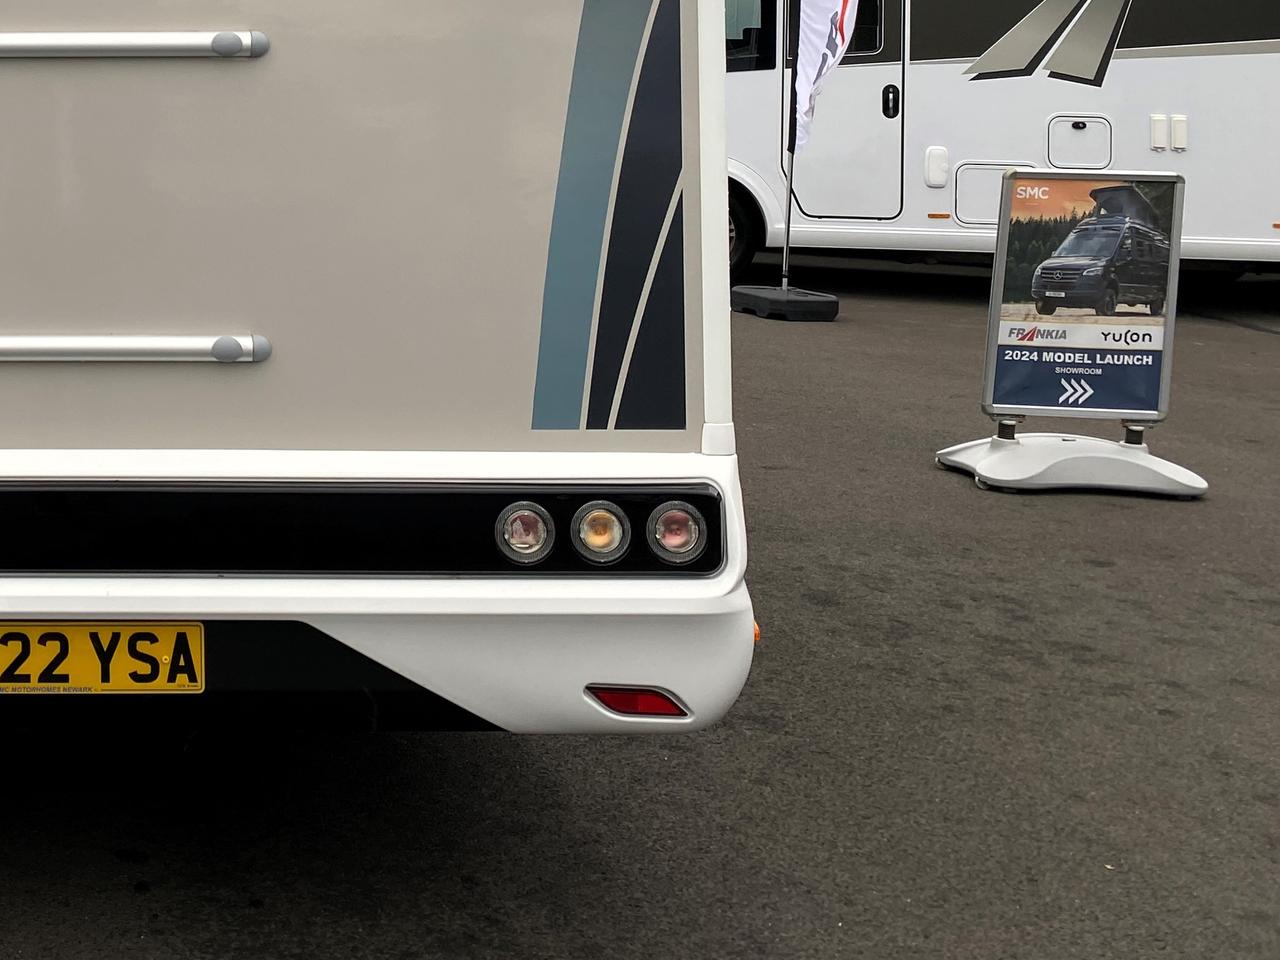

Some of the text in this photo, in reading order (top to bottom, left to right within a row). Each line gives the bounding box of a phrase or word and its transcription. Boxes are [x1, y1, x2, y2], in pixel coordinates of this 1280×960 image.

[1016, 186, 1049, 199] SMC
[1008, 326, 1067, 342] FRANKIA
[1004, 350, 1153, 365] 2024 MODEL LAUNCH
[1055, 366, 1102, 375] SHOWROOM
[88, 632, 198, 684] YSA
